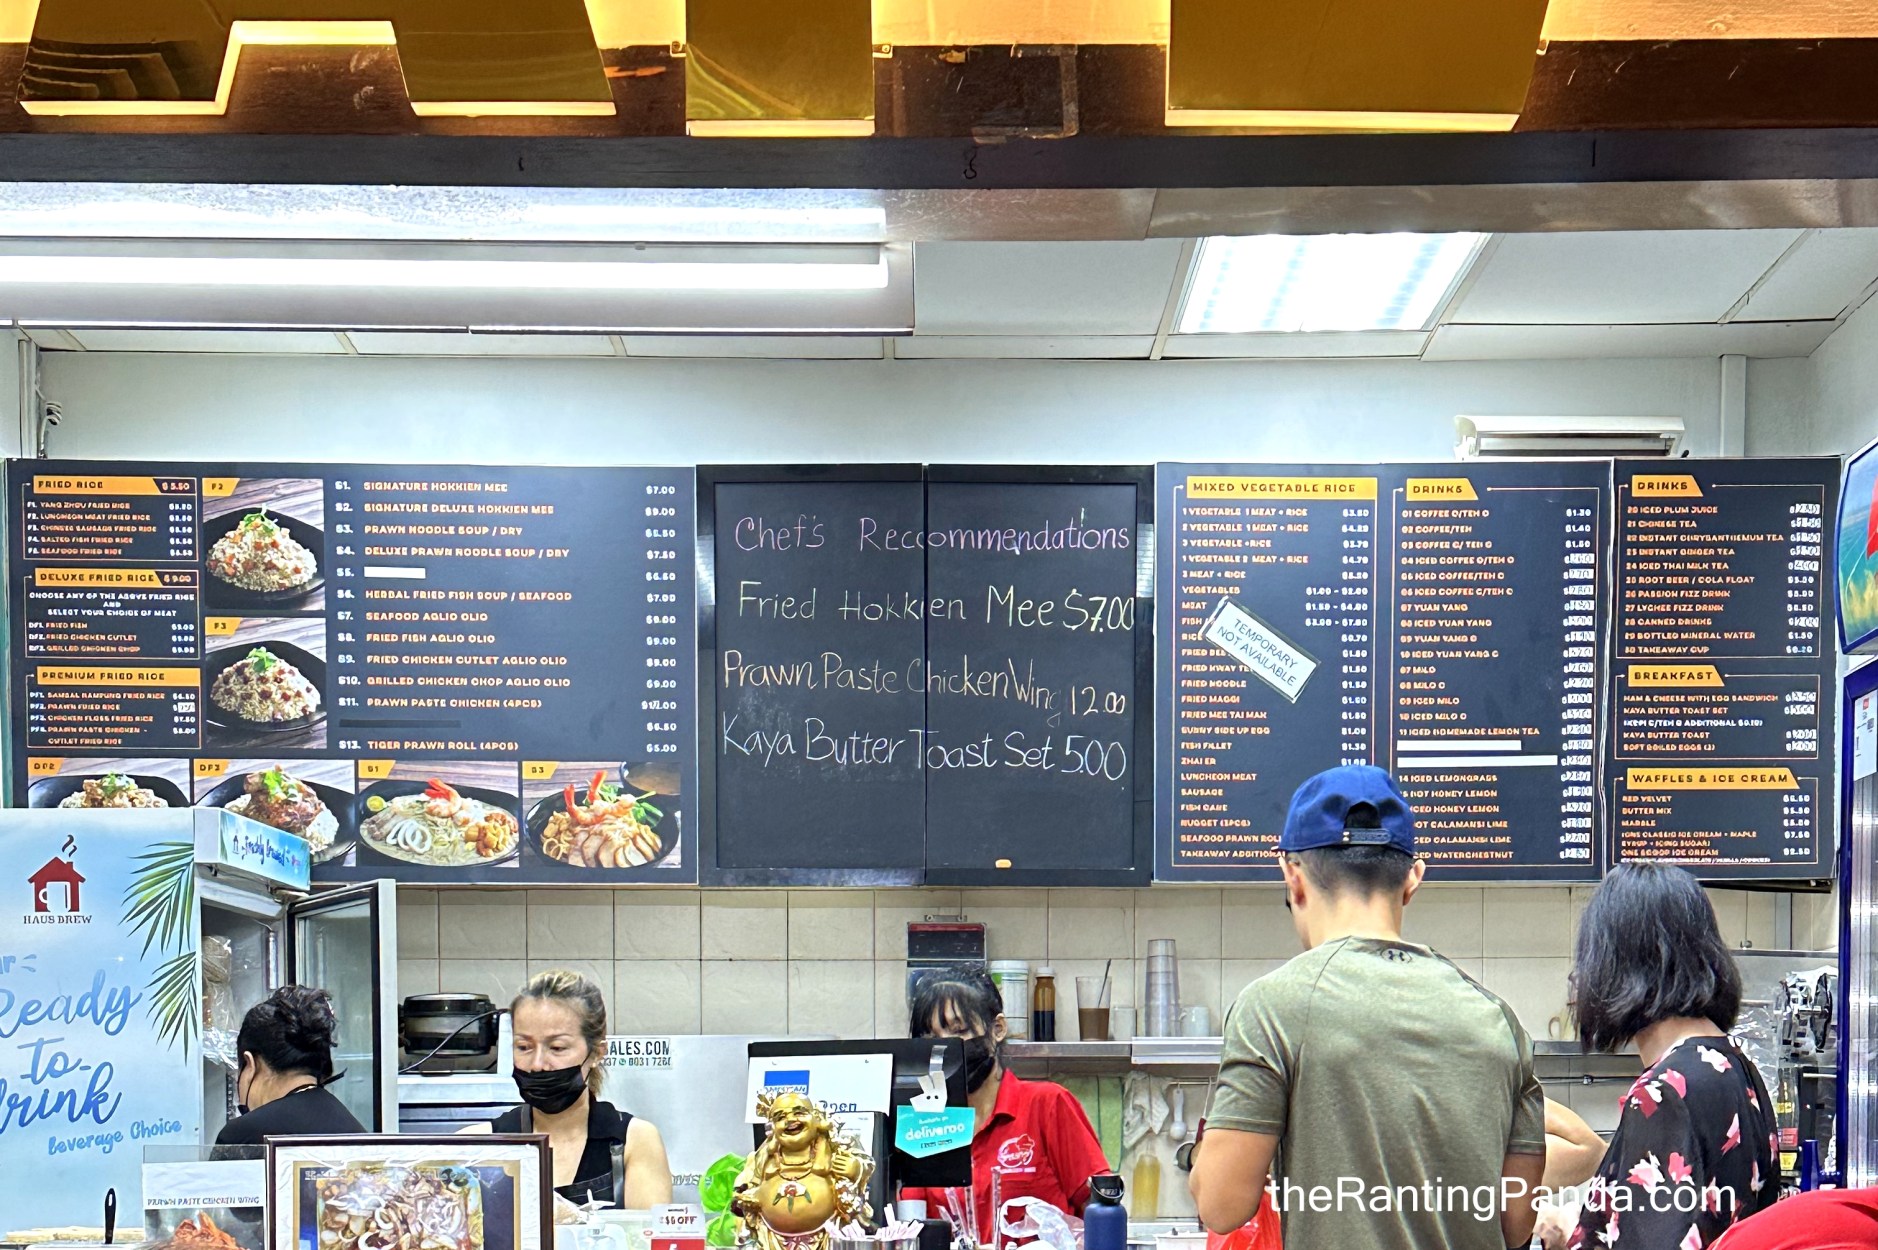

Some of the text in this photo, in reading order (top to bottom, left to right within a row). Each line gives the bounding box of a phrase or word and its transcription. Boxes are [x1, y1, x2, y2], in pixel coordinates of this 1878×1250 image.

[363, 482, 428, 491] SIGNATURE
[431, 482, 481, 492] HOKKIEN
[646, 486, 675, 495] $7.00
[1193, 484, 1356, 493] MIXED VEGETABLE RICE
[1413, 485, 1463, 494] DRINKS
[1638, 482, 1688, 490] DRINKS
[364, 504, 428, 513] SIGNATURE
[432, 504, 474, 513] DELUXE
[478, 505, 528, 514] HOKKIEN
[364, 526, 406, 534] PRAWN
[408, 526, 455, 535] NOODLE
[458, 527, 489, 536] SOUP
[500, 527, 523, 536] DRY
[734, 514, 826, 551] Chef's
[365, 547, 407, 556] DELUXE
[411, 547, 452, 557] PRAWN
[456, 548, 502, 557] NOODLE
[505, 548, 535, 558] SOUP
[365, 590, 410, 599] HERBAL
[413, 591, 445, 600] FRIED
[448, 591, 474, 600] FISH
[477, 591, 508, 600] SOUP
[519, 592, 572, 601] SEAFOOD
[739, 580, 1135, 632] Fried Hokkien Mee $7.00
[366, 613, 419, 621] SEAFOOD
[423, 613, 458, 621] AGLIO
[461, 613, 488, 621] OLIO
[366, 634, 398, 643] FRIED
[402, 634, 427, 643] FISH
[430, 634, 465, 643] AGLIO
[468, 634, 495, 643] OLIO
[1233, 618, 1298, 669] TEMPORARY
[367, 656, 399, 664] FRIED
[402, 656, 452, 665] CHICKEN
[456, 656, 498, 665] CUTLET
[502, 656, 537, 665] AGLIO
[540, 656, 567, 665] OLIO
[1217, 626, 1297, 686] NOT AVAILABLE
[42, 672, 95, 680] PREMIUM
[101, 672, 133, 680] FRIED
[1635, 672, 1713, 680] BREAKFAST
[367, 677, 414, 686] GRILLED
[417, 677, 468, 686] CHICKEN
[471, 677, 503, 687] CHOP
[506, 678, 540, 687] AGLIO
[544, 678, 570, 687] OLIO
[723, 650, 1127, 728] Prawn Paste Chicken Wing 12.00
[367, 699, 408, 708] PRAWN
[411, 699, 446, 708] PASTE
[450, 699, 500, 708] CHICKEN
[367, 741, 401, 750] TIGER
[404, 741, 445, 750] PRAWN
[448, 741, 476, 750] ROLL
[722, 712, 797, 768] Kaya
[805, 717, 905, 765] Butter
[909, 729, 998, 770] Toast
[1005, 731, 1056, 769] Set
[1633, 775, 1693, 783] WAFFLES
[1713, 775, 1735, 783] ICE
[1741, 775, 1788, 783] CREAM
[23, 915, 55, 925] HAUS
[130, 1118, 182, 1141] Choice
[905, 1123, 965, 1141] deliveroo
